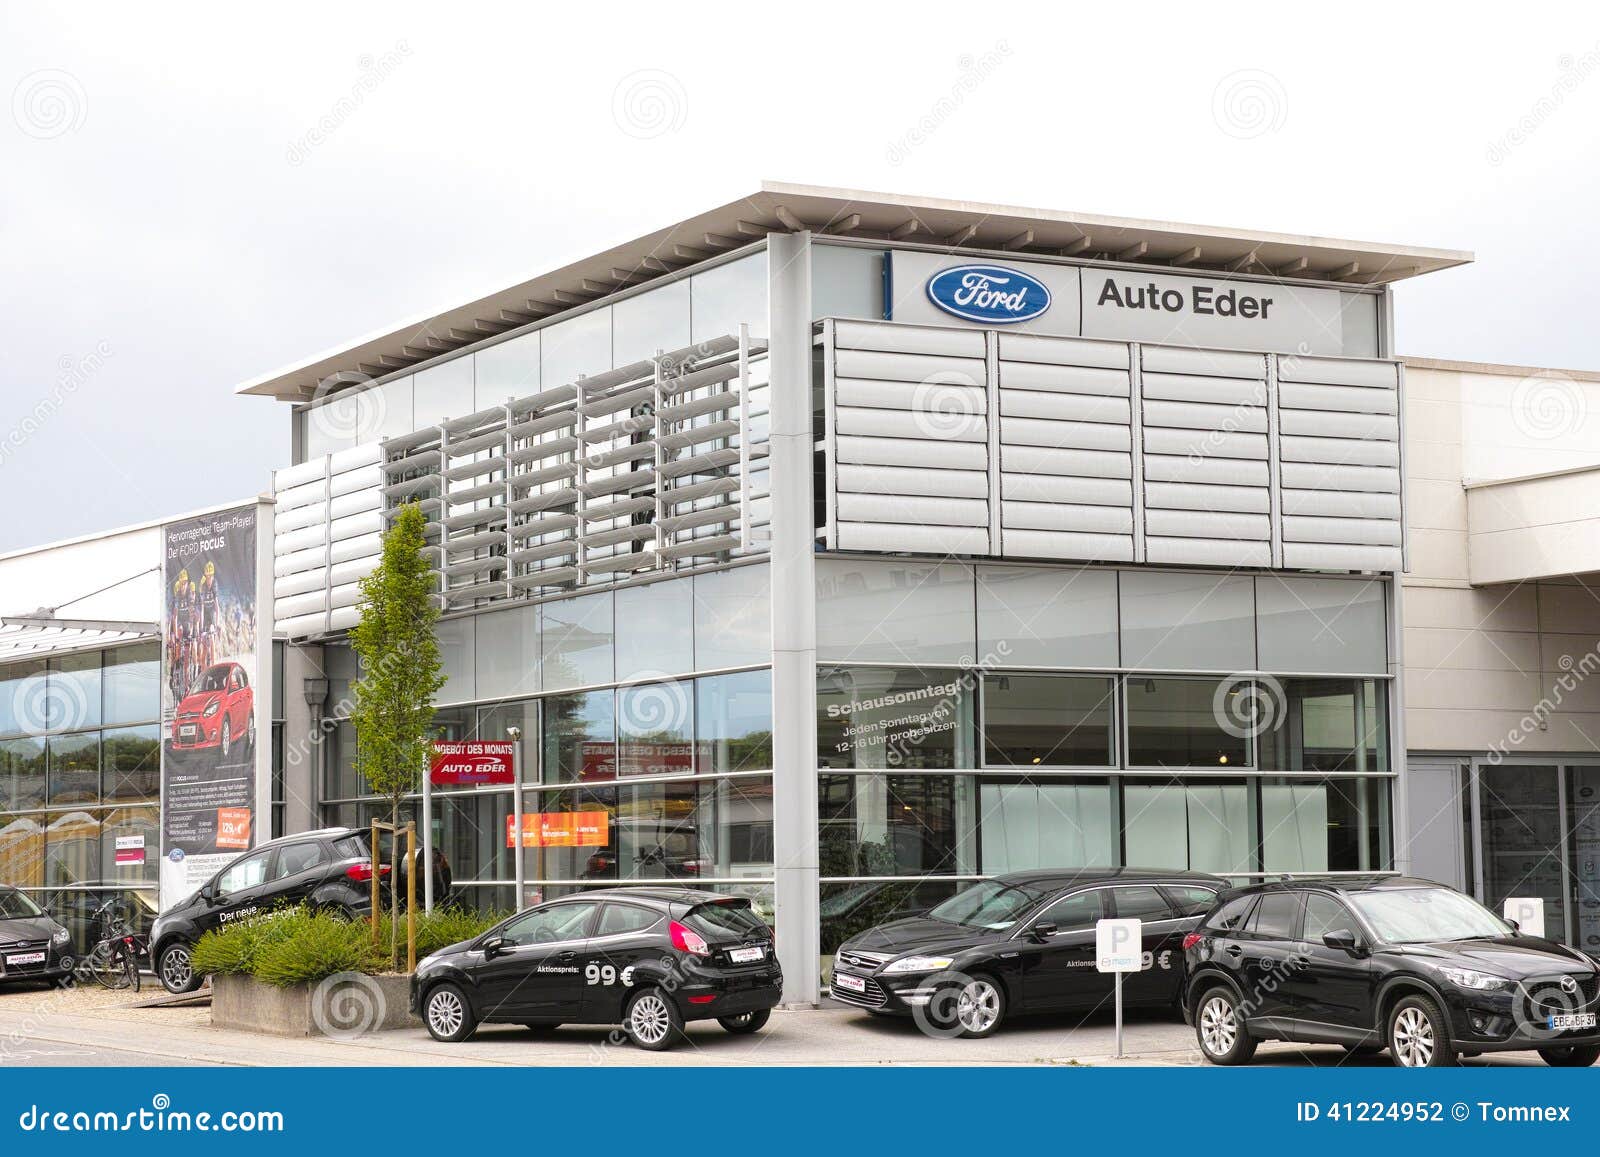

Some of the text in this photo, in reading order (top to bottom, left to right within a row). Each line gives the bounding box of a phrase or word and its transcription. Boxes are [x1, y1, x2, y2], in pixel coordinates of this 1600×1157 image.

[954, 273, 1027, 312] Ford
[1098, 278, 1273, 320] Auto Eder
[168, 514, 254, 543] Hervorragender Team-Player!
[168, 547, 178, 559] Der
[180, 542, 199, 556] FORD
[827, 679, 961, 718] Schausonntag!
[843, 707, 950, 737] Jeden Sonntag von
[835, 721, 960, 753] 12-16 Uhr probesitzen.
[467, 744, 483, 755] DES
[484, 744, 513, 755] MONATS
[441, 764, 506, 773] AUTO EDER
[219, 912, 234, 923] Der
[235, 906, 258, 919] neue
[1111, 925, 1129, 954] P
[537, 965, 579, 974] Aktionspreis:
[1066, 960, 1096, 968] Aktionsp
[1141, 950, 1172, 971] 9 €
[585, 964, 635, 987] 99 €
[1553, 1016, 1570, 1028] EBE
[1586, 1014, 1595, 1025] 37
